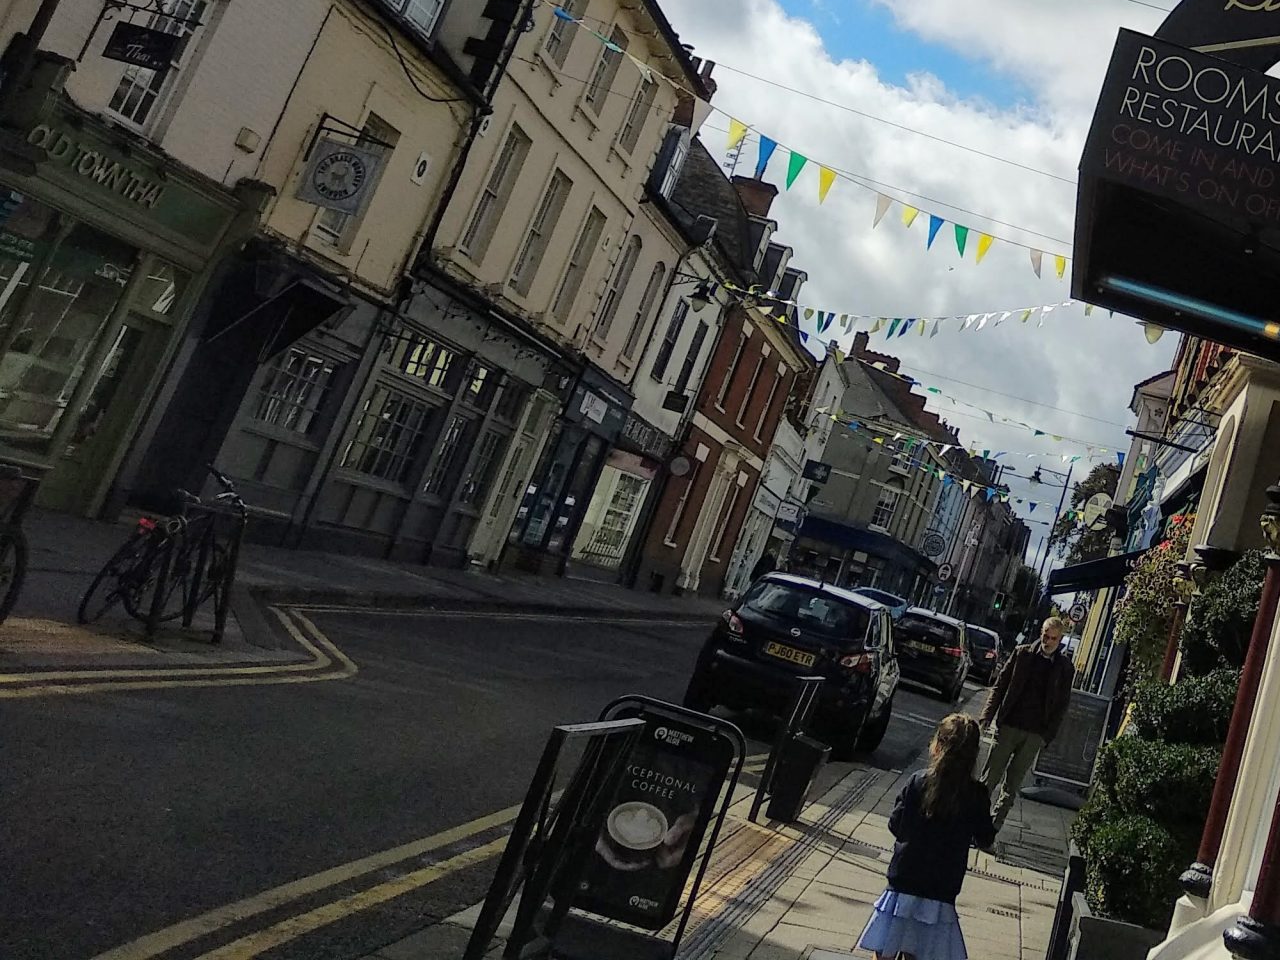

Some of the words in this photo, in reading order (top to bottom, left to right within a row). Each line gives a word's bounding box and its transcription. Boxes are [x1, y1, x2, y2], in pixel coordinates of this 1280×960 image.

[26, 124, 72, 158] OLD
[71, 142, 127, 190] TOWN
[1104, 147, 1191, 193] WHAT'S
[1197, 178, 1239, 208] ON
[1111, 123, 1184, 161] COME
[1189, 145, 1218, 172] IN
[1221, 158, 1275, 189] AND
[768, 643, 793, 659] PJ60
[793, 651, 813, 665] ETR
[627, 764, 696, 793] XCEPTIONAL
[631, 779, 675, 799] COFFEE
